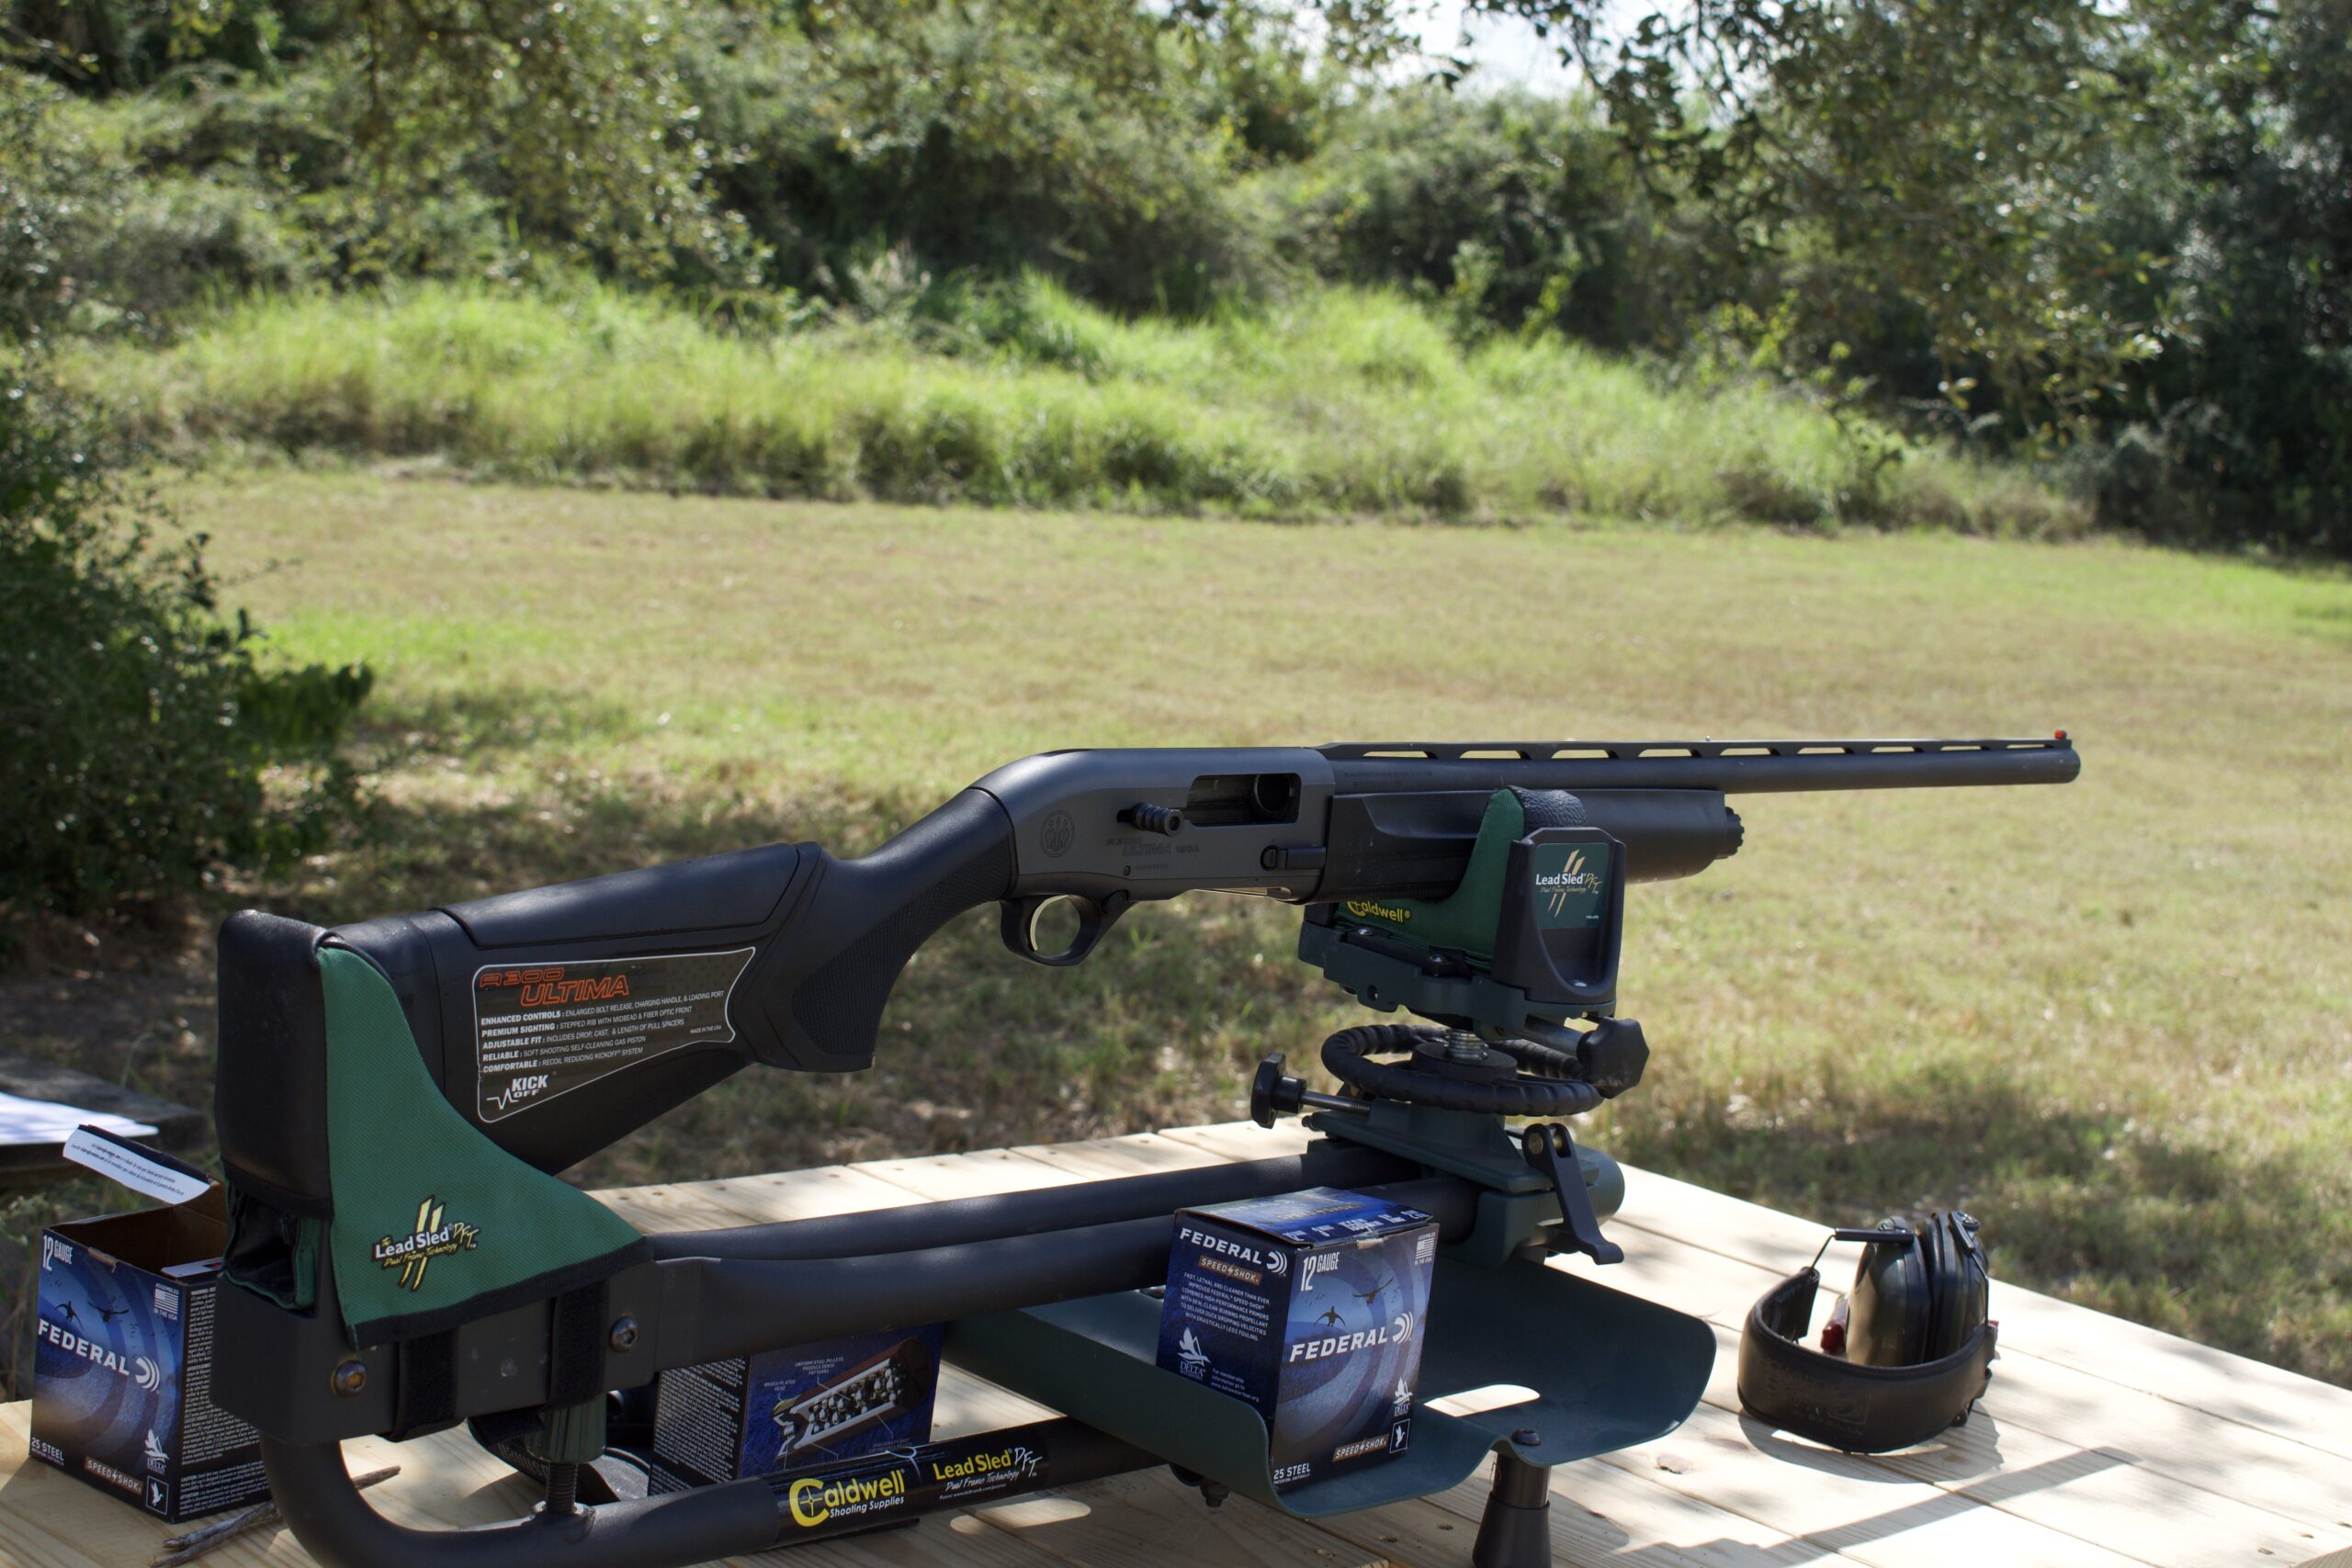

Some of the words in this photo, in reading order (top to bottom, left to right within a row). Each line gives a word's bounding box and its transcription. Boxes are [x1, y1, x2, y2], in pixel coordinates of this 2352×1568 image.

[1535, 874, 1561, 886] Lead
[1562, 873, 1584, 886] Sled
[480, 967, 565, 987] A300
[520, 976, 629, 1007] ULTIMA
[481, 1014, 522, 1026] ENHANCED
[566, 1007, 595, 1018] ENLARGED
[595, 1005, 609, 1015] BOLT
[634, 998, 661, 1009] CHARGING
[688, 992, 710, 1001] LOADING
[710, 990, 724, 999] PORT
[481, 1027, 519, 1038] PREMIUM
[560, 1020, 586, 1030] STEPPED
[586, 1019, 597, 1027] RIB
[597, 1016, 612, 1025] WITH
[612, 1013, 638, 1023] MIDBEAD
[643, 1010, 659, 1019] FIBER
[659, 1008, 674, 1017] OPTIC
[674, 1005, 693, 1015] FRONT
[482, 1037, 530, 1050] ADJUSTABLE
[546, 1032, 575, 1043] INCLUDES
[616, 1024, 639, 1034] LENGTH
[647, 1021, 662, 1030] PULL
[662, 1018, 685, 1028] SPACERS
[523, 1048, 539, 1057] SOFT
[539, 1044, 570, 1055] SHOOTING
[570, 1038, 615, 1052] SELF-CLEANING
[615, 1037, 627, 1046] GAS
[627, 1035, 647, 1044] PISTON
[542, 1056, 563, 1066] RECOIL
[563, 1053, 594, 1064] REDUCING
[621, 1046, 644, 1056] SYSTEM
[511, 1074, 548, 1092] KICK
[514, 1088, 540, 1099] OFF
[43, 1235, 54, 1271] 12
[53, 1239, 74, 1265] GAUGE
[376, 1235, 415, 1258] Lead
[416, 1226, 450, 1248] Sled
[1180, 1227, 1262, 1265] FEDERAL
[1201, 1257, 1227, 1273] SPEED
[1234, 1268, 1258, 1282] SHOK
[1300, 1255, 1317, 1292] 12
[1317, 1251, 1340, 1273] GAUGE
[155, 1281, 180, 1295] ASSEMBLED
[38, 1318, 130, 1376] FEDERAL
[1289, 1325, 1388, 1363] FEDERAL
[1180, 1360, 1204, 1378] DELTA
[30, 1437, 40, 1450] 25
[41, 1441, 65, 1461] STEEL
[1335, 1444, 1359, 1460] SPEED
[1364, 1437, 1385, 1451] SHOK
[87, 1460, 112, 1478] SPEED
[118, 1473, 139, 1493] SHOK
[932, 1456, 975, 1481] Lead
[975, 1449, 1012, 1472] Sled
[1273, 1468, 1285, 1480] 25
[1286, 1462, 1312, 1477] STEEL
[944, 1479, 964, 1493] Dual
[963, 1476, 986, 1488] Frame
[987, 1470, 1021, 1483] Technology
[788, 1469, 905, 1528] Caldwell
[829, 1504, 867, 1518] Shooting
[869, 1496, 905, 1510] Supplies
